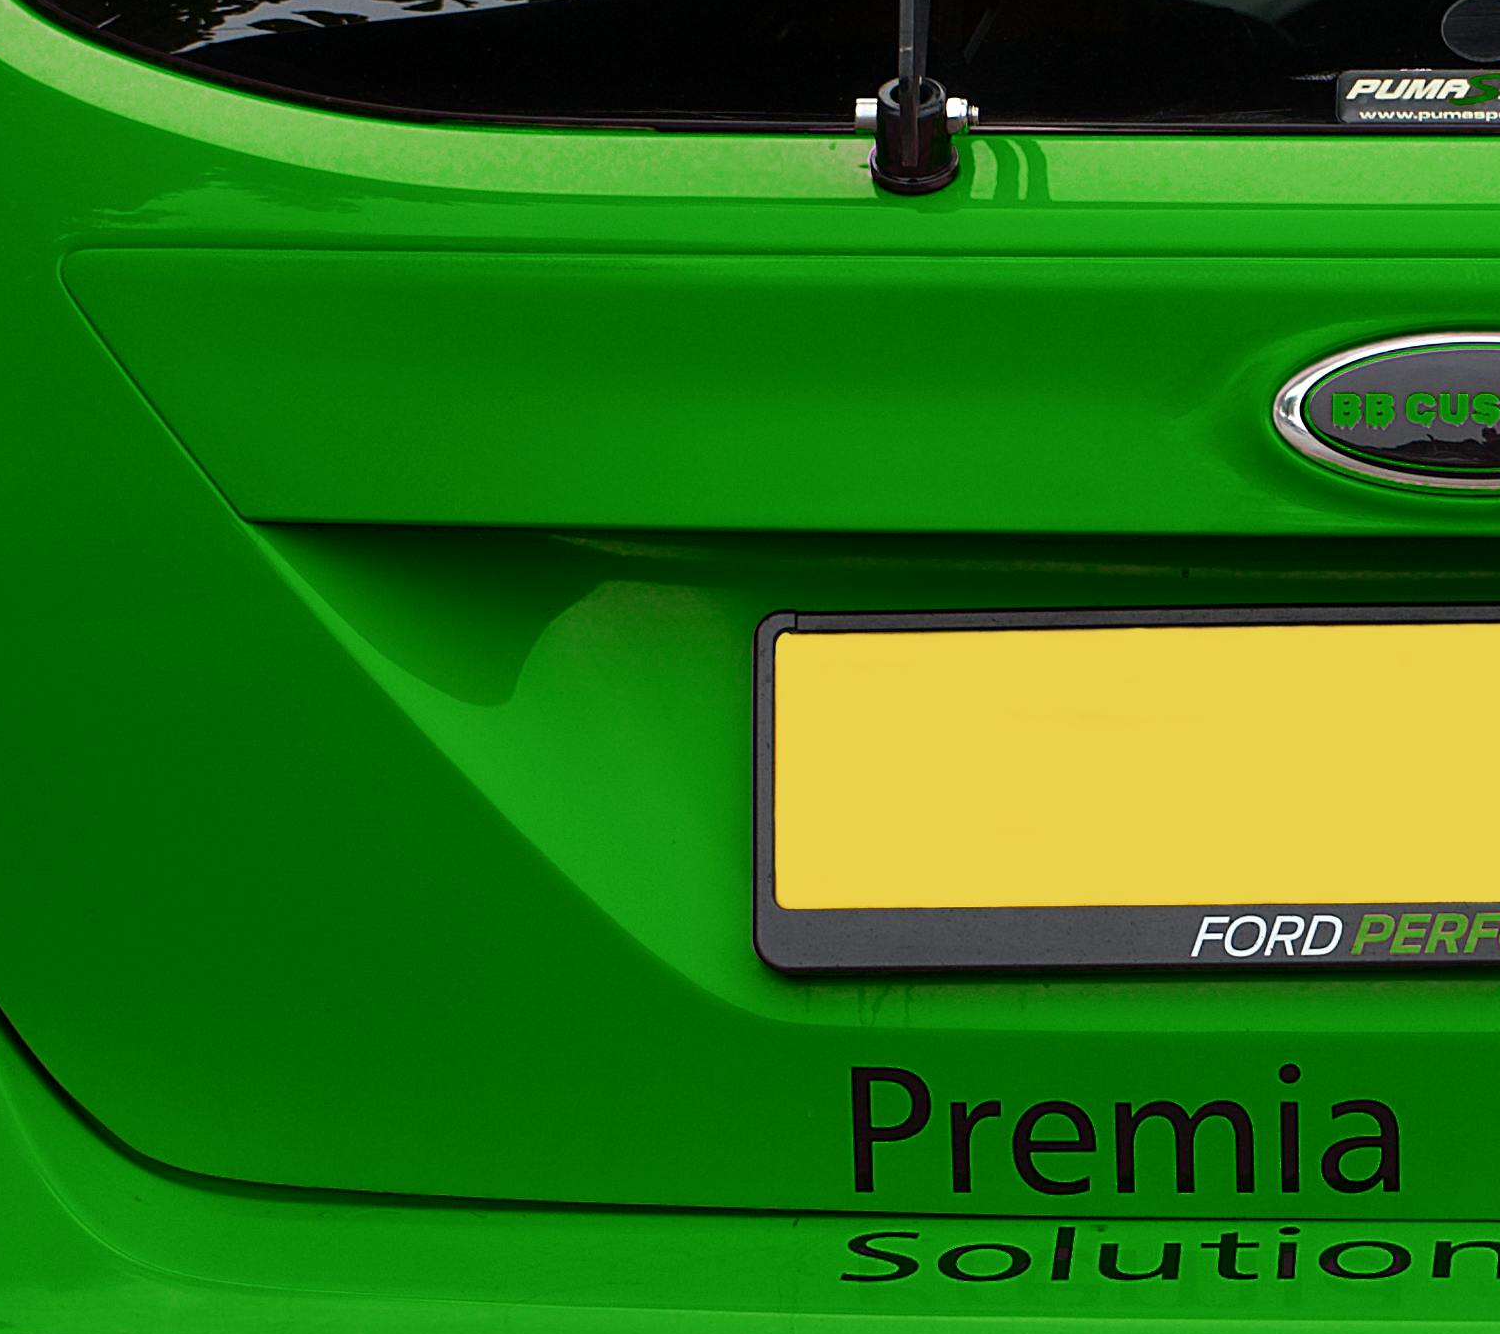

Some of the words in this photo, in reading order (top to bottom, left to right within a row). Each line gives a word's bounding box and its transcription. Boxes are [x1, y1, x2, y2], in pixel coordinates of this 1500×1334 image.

[1332, 392, 1396, 430] BB
[1191, 914, 1343, 957] FORD
[850, 1063, 1402, 1194] Premia
